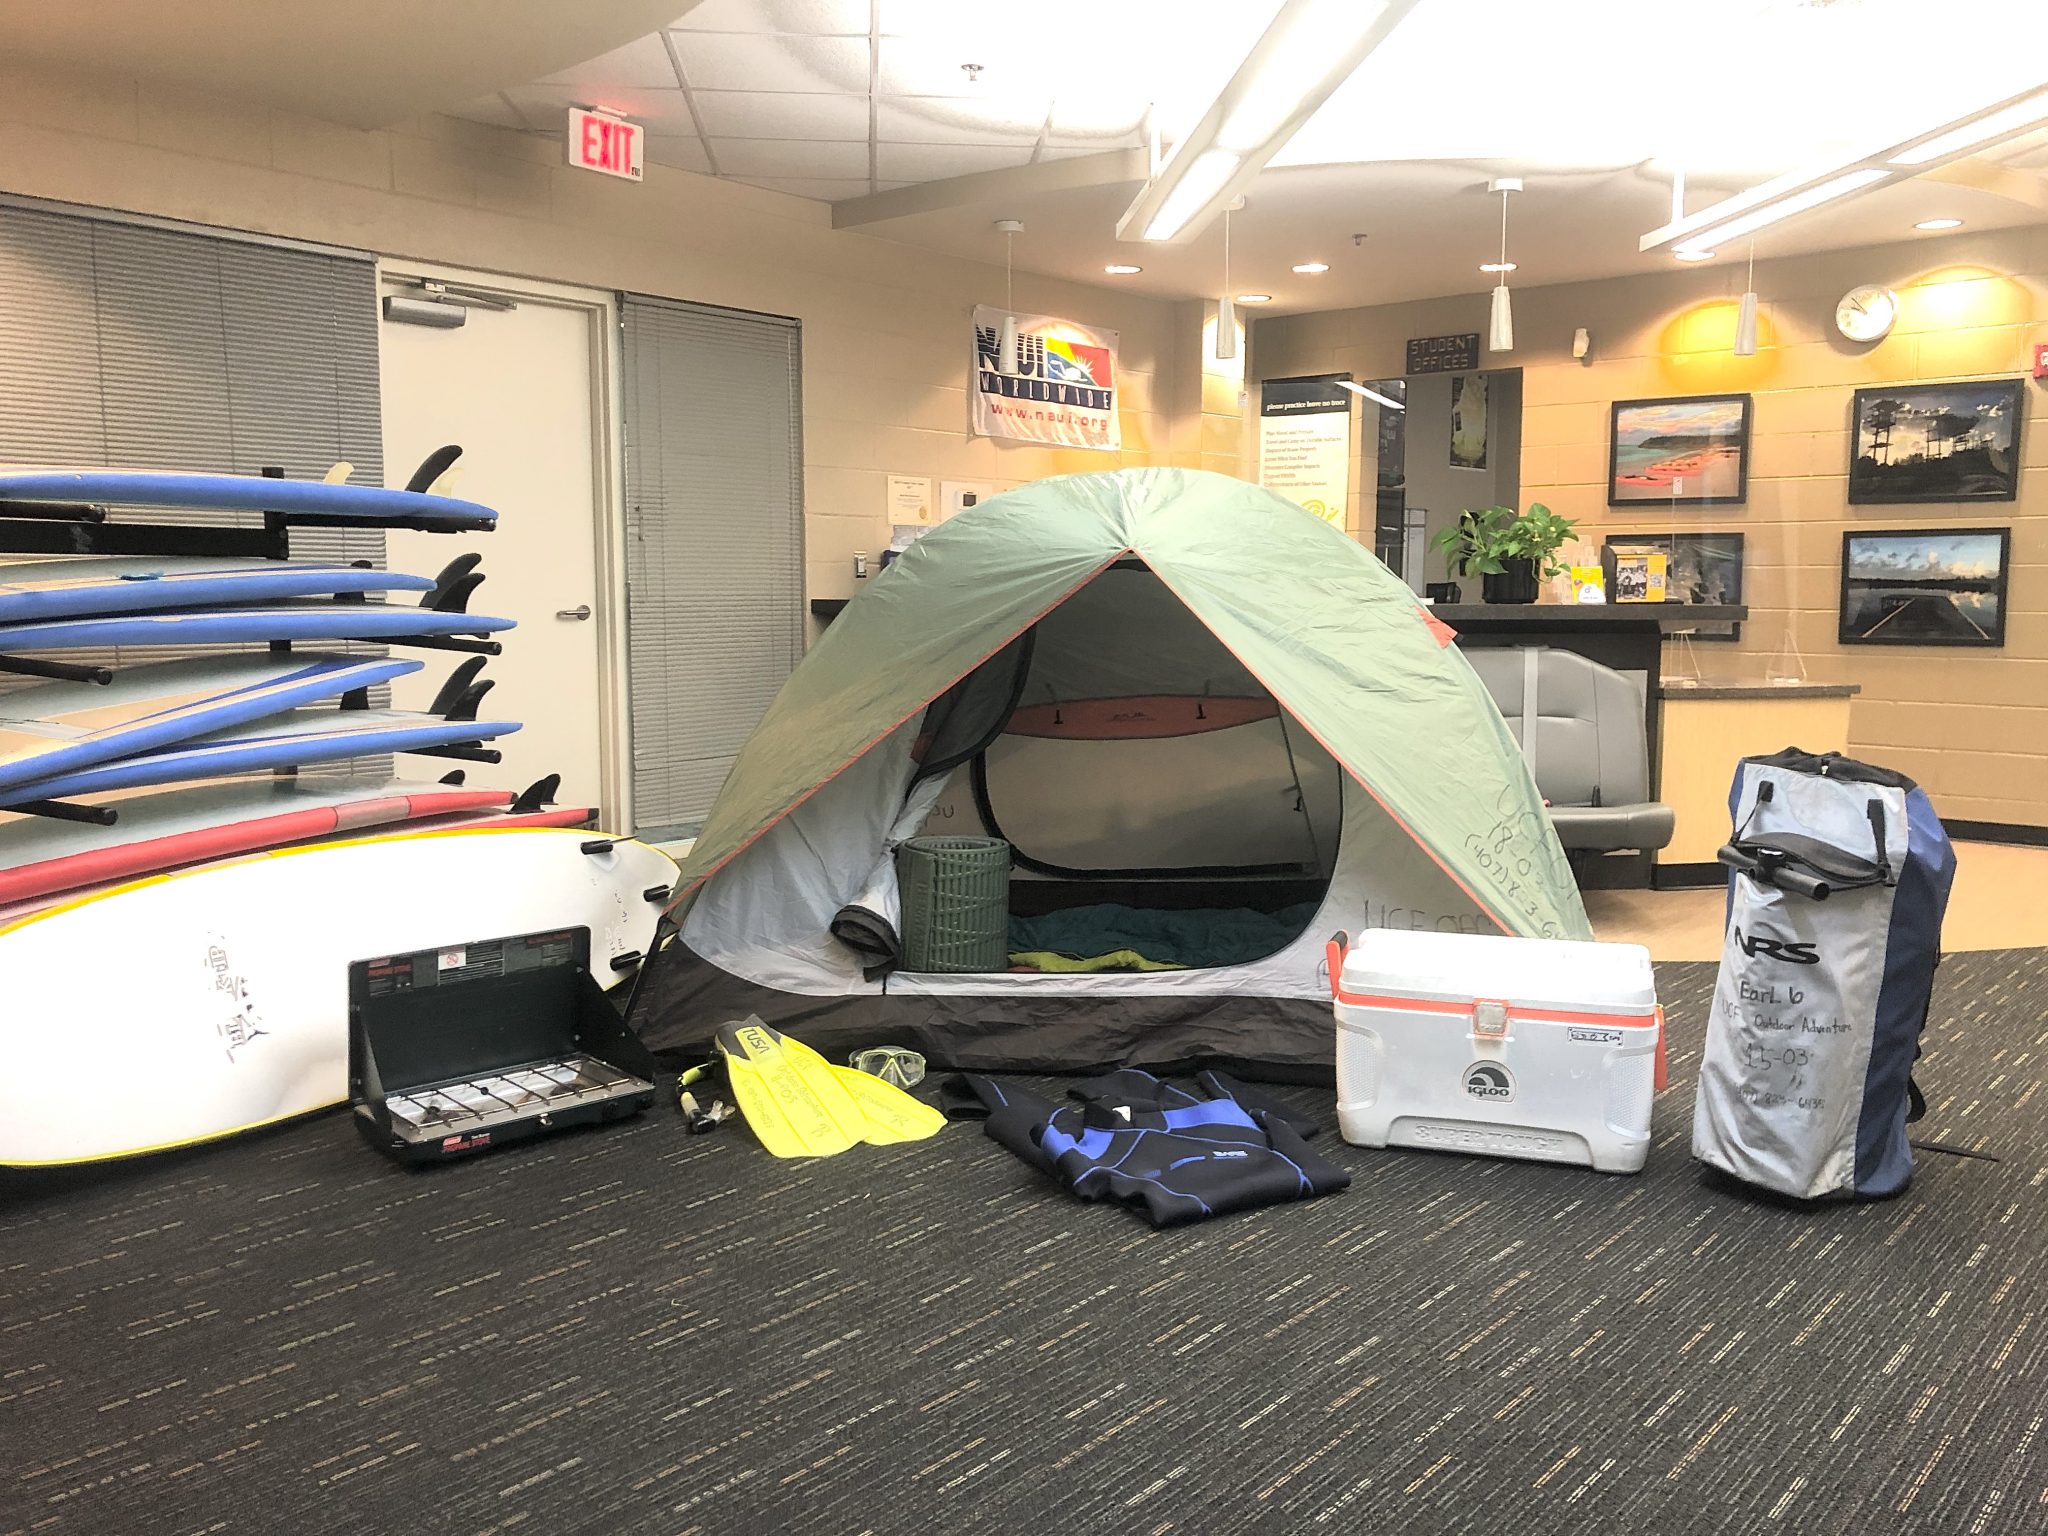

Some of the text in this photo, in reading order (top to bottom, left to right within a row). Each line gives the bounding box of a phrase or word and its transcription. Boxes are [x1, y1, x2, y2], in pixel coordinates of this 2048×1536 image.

[582, 115, 635, 175] EXIT
[1411, 335, 1475, 355] STUDENT
[1414, 353, 1468, 372] OFFICES
[980, 371, 1110, 410] WORLDWIDE
[991, 403, 1108, 431] www.naui.org
[1284, 401, 1306, 411] practice
[1306, 400, 1322, 408] leave
[1734, 924, 1821, 965] NRS
[1721, 998, 1742, 1019] UCF
[1754, 1013, 1795, 1031] Outdoor
[742, 1026, 771, 1055] TUSA
[1467, 1085, 1510, 1098] IGLOO
